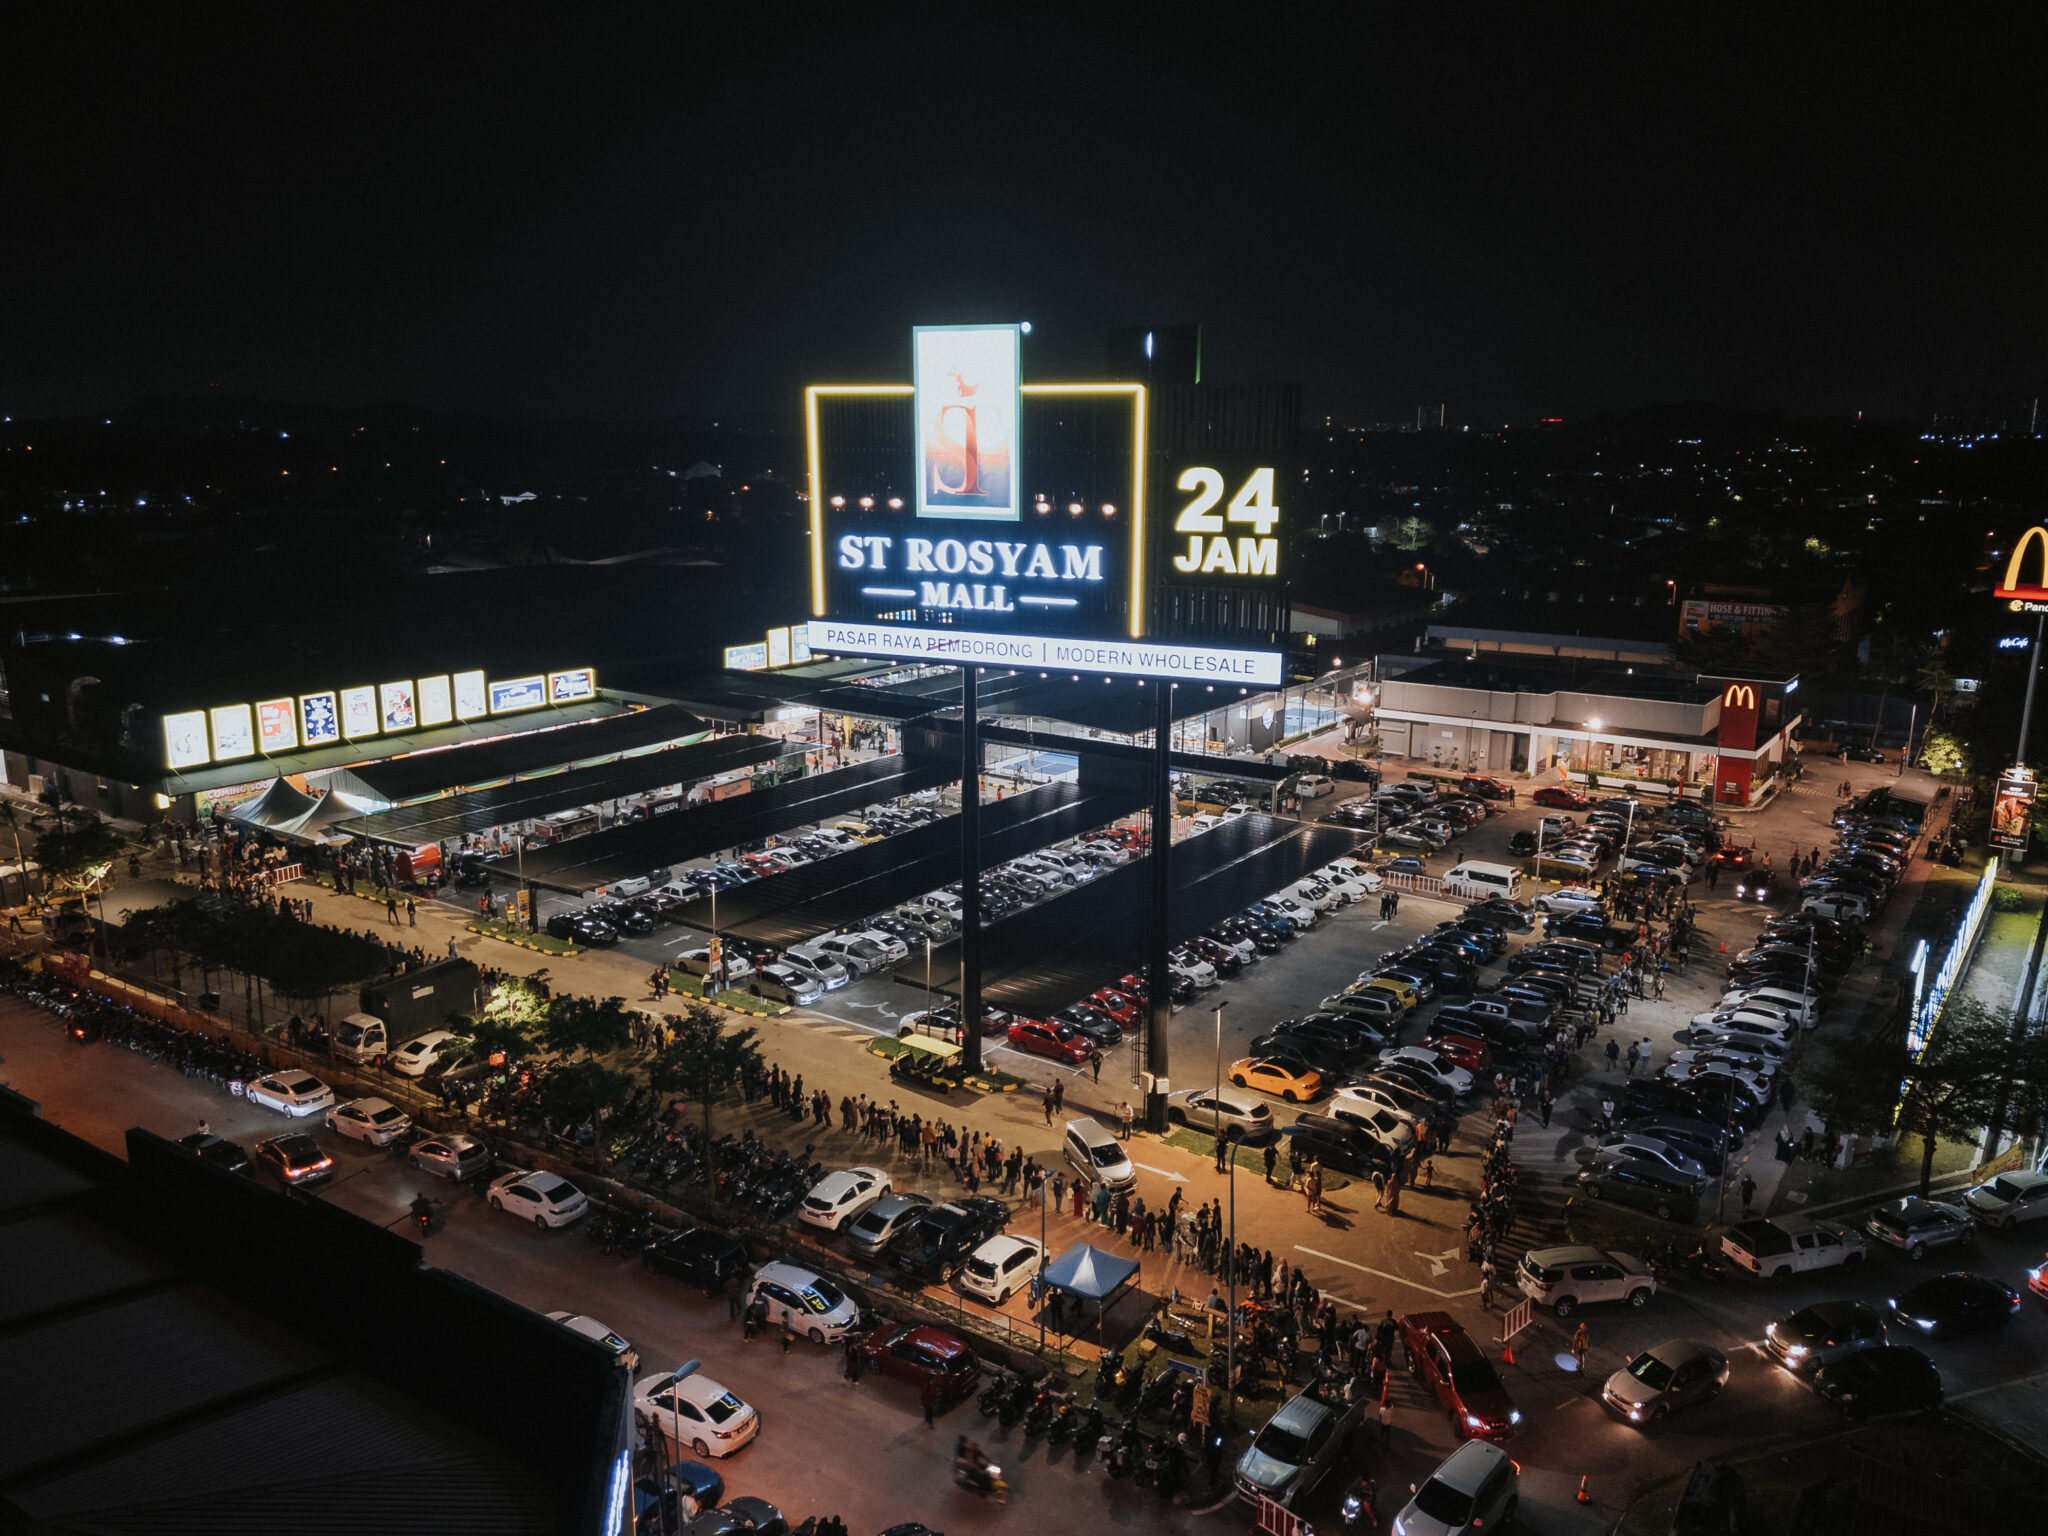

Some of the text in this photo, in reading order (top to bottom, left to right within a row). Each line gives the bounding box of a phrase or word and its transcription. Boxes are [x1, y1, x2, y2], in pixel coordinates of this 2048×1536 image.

[1175, 467, 1279, 535] 24
[840, 536, 1104, 580] ST ROSYAM
[1174, 537, 1279, 575] JAM
[920, 581, 1014, 611] MALL
[1710, 604, 1732, 614] HOSE
[827, 629, 1256, 675] PASAR RAYA PEMBORONG MODERN WHOLESALE
[207, 787, 247, 799] COMING
